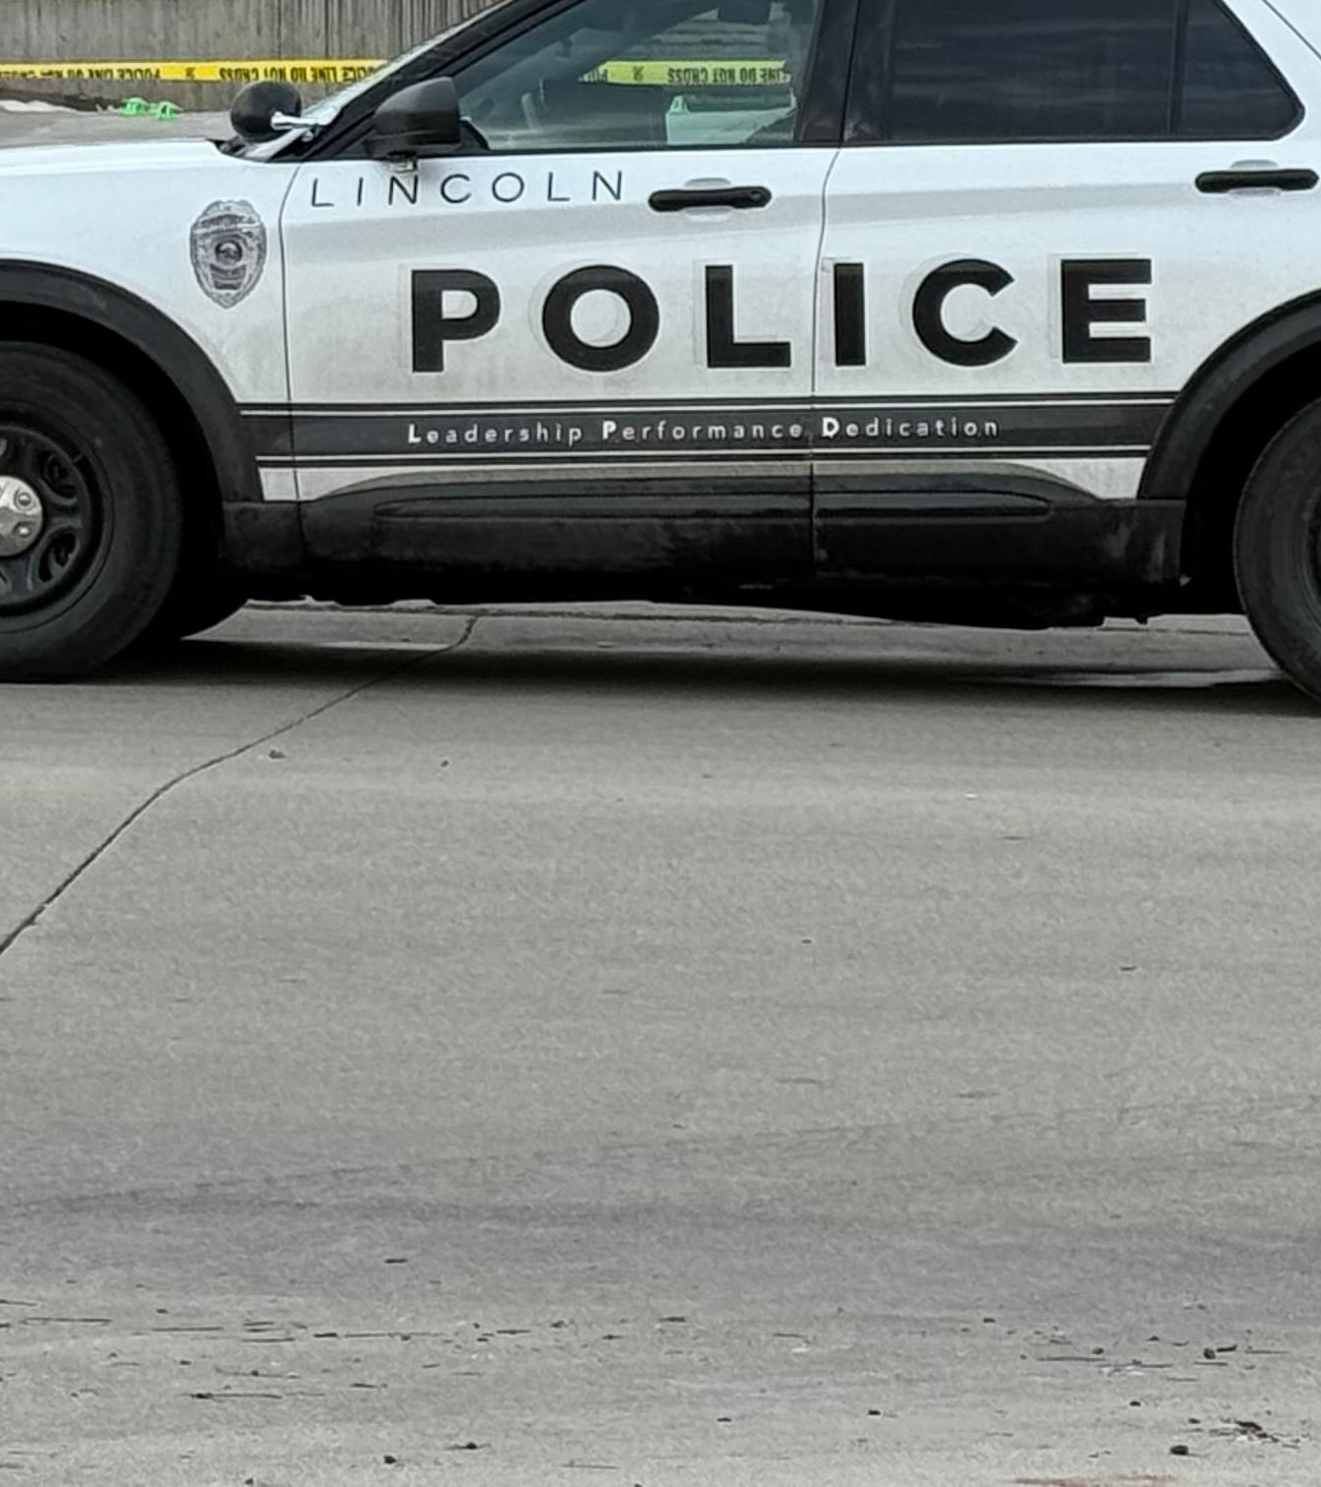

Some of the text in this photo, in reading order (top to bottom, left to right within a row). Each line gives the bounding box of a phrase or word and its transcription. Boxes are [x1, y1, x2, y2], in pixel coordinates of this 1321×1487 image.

[310, 169, 623, 208] LINCOLN
[410, 257, 1152, 373] POLICE
[407, 415, 1000, 447] Leadership Performance Dedication
